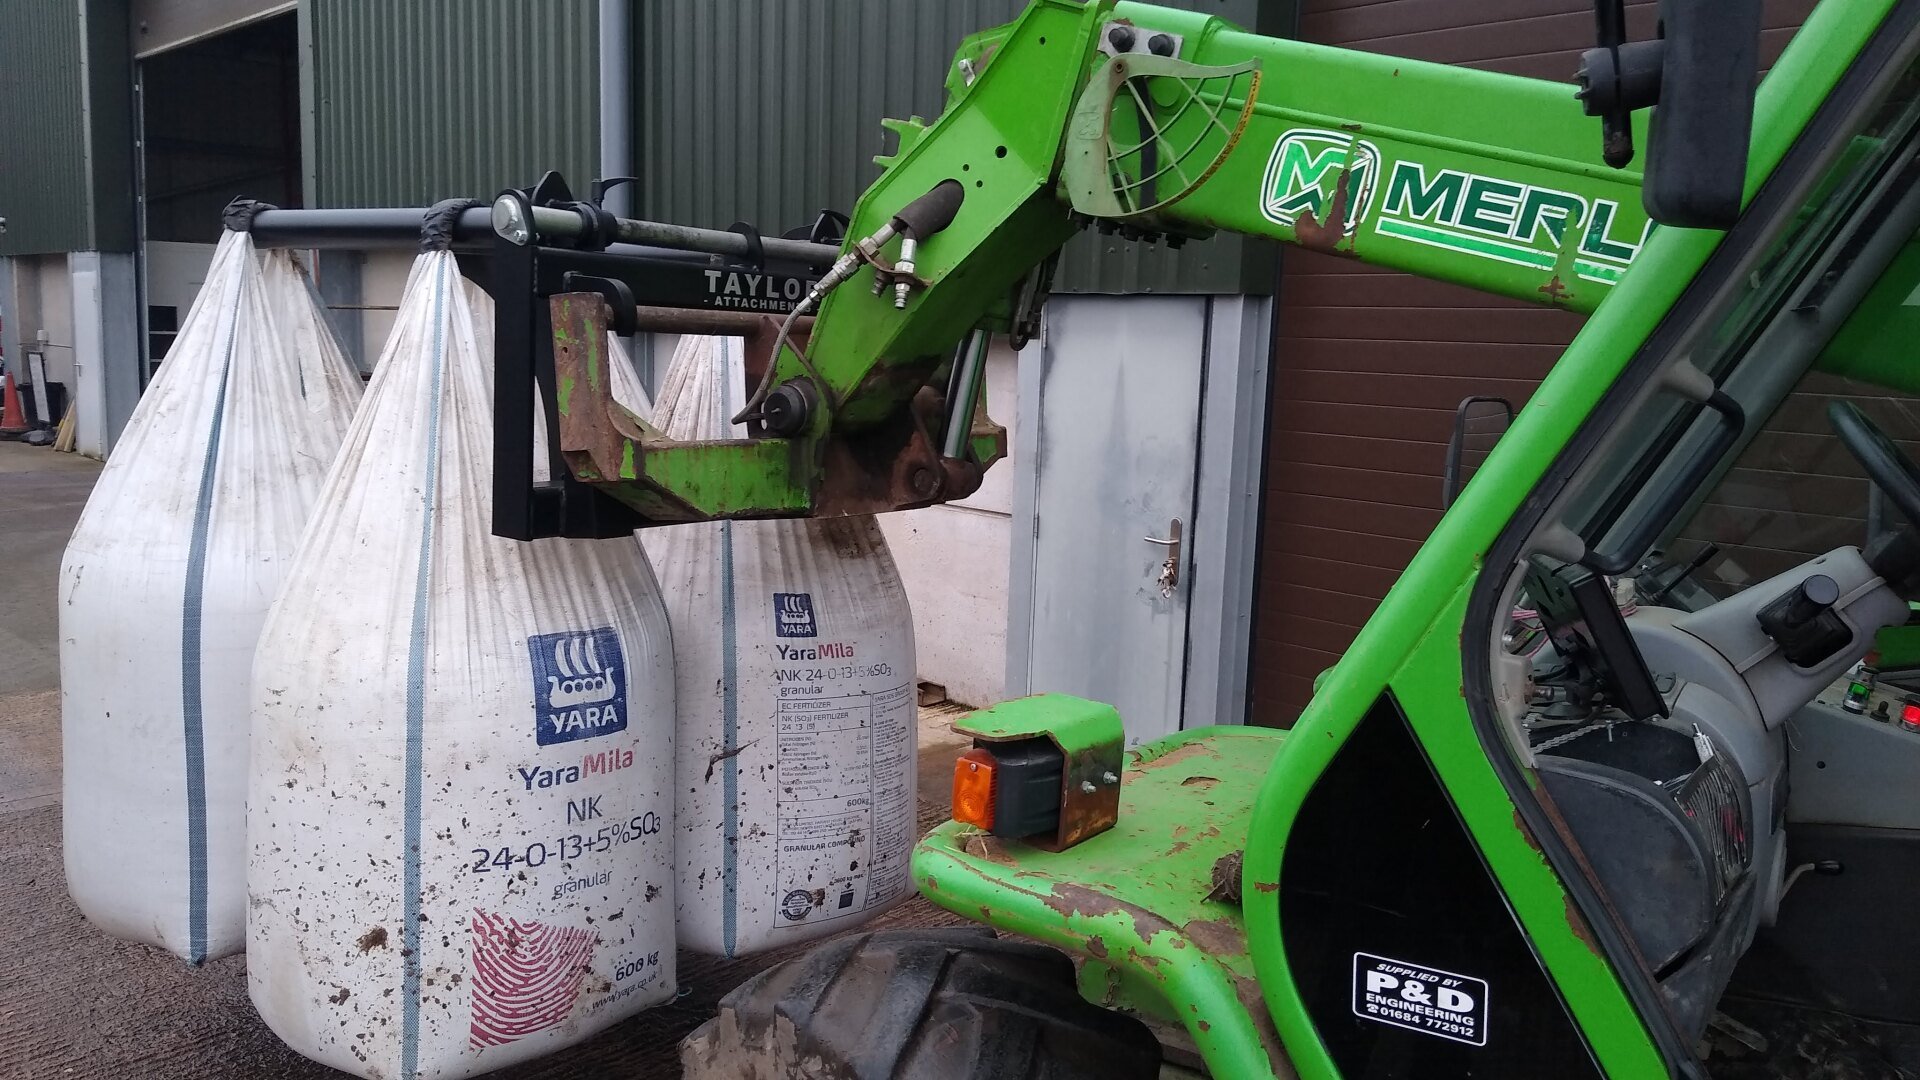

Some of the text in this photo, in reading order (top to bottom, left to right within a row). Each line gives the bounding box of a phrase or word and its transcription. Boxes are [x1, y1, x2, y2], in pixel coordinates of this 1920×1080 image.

[1380, 160, 1658, 265] MERL
[781, 624, 813, 635] YARA
[776, 642, 855, 661] YaraMila
[780, 669, 802, 682] NK
[780, 685, 824, 697] granular
[781, 715, 793, 723] NK
[813, 712, 849, 721] FERTILIZER
[793, 701, 832, 709] FERTILIZER
[549, 704, 619, 735] YARA
[781, 723, 792, 731] 24
[518, 748, 634, 791] YaraMila
[567, 794, 603, 825] NK
[783, 843, 826, 853] GRANULAR
[553, 870, 613, 900] granular
[615, 950, 660, 982] 600 kg
[1376, 963, 1463, 988] SUPPLIED BY
[1365, 992, 1475, 1027] ENGINEERING
[1380, 1007, 1475, 1038] 01684 772912
